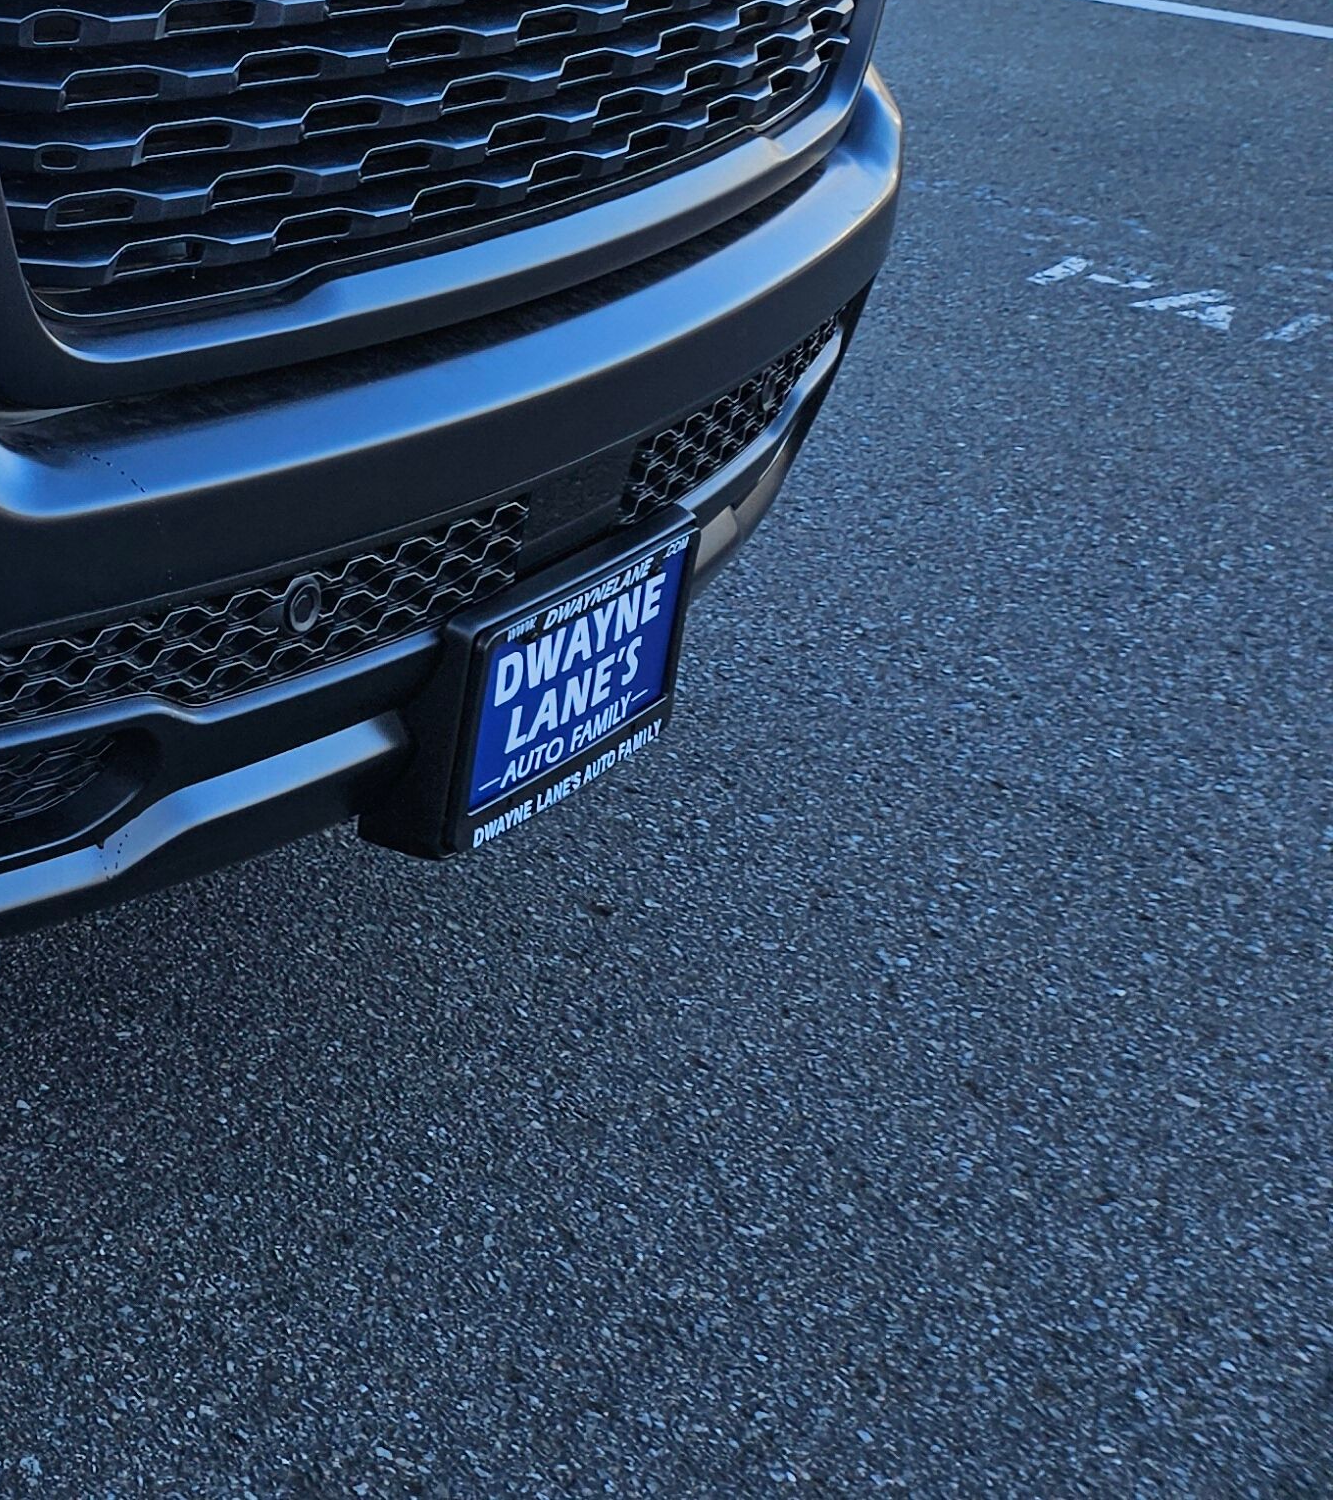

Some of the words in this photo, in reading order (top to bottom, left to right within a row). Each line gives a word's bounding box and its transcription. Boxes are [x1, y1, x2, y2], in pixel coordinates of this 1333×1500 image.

[494, 572, 667, 707] DWAYNE
[504, 636, 642, 755] LANE'S
[472, 800, 534, 849] DWAYNE
[536, 771, 582, 813] LANE'S
[583, 750, 616, 785] AUTO
[617, 719, 663, 762] FAMILY
[499, 737, 564, 789] AUTO
[569, 691, 633, 753] FAMILY
